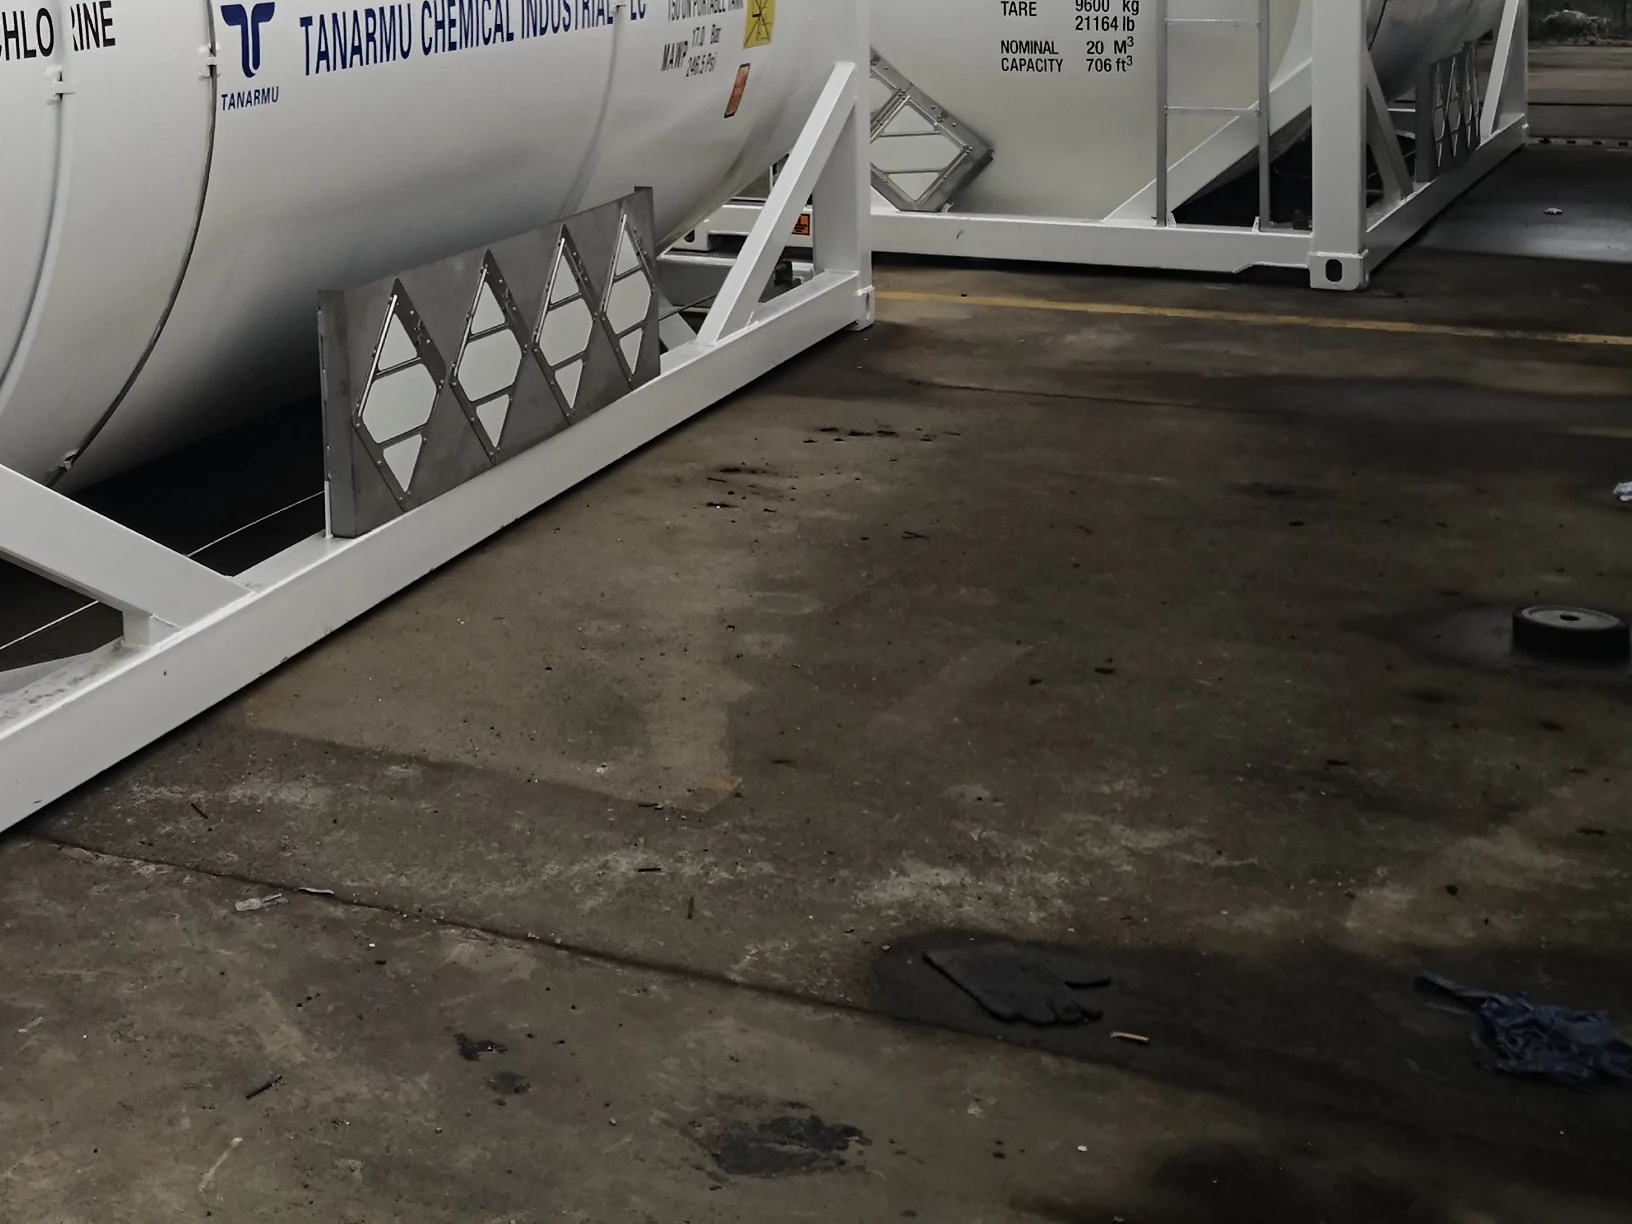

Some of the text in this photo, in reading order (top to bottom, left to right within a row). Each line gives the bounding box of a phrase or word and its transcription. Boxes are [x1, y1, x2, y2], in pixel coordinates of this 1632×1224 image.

[1001, 1, 1037, 17] TARE
[1075, 16, 1135, 32] 21164 lb
[299, 3, 412, 76] TANARMU
[1001, 40, 1059, 55] NOMINAL
[1086, 40, 1104, 55] 20
[1001, 58, 1064, 73] CAPACITY
[1086, 58, 1112, 73] 706
[221, 86, 279, 111] TANARMU
